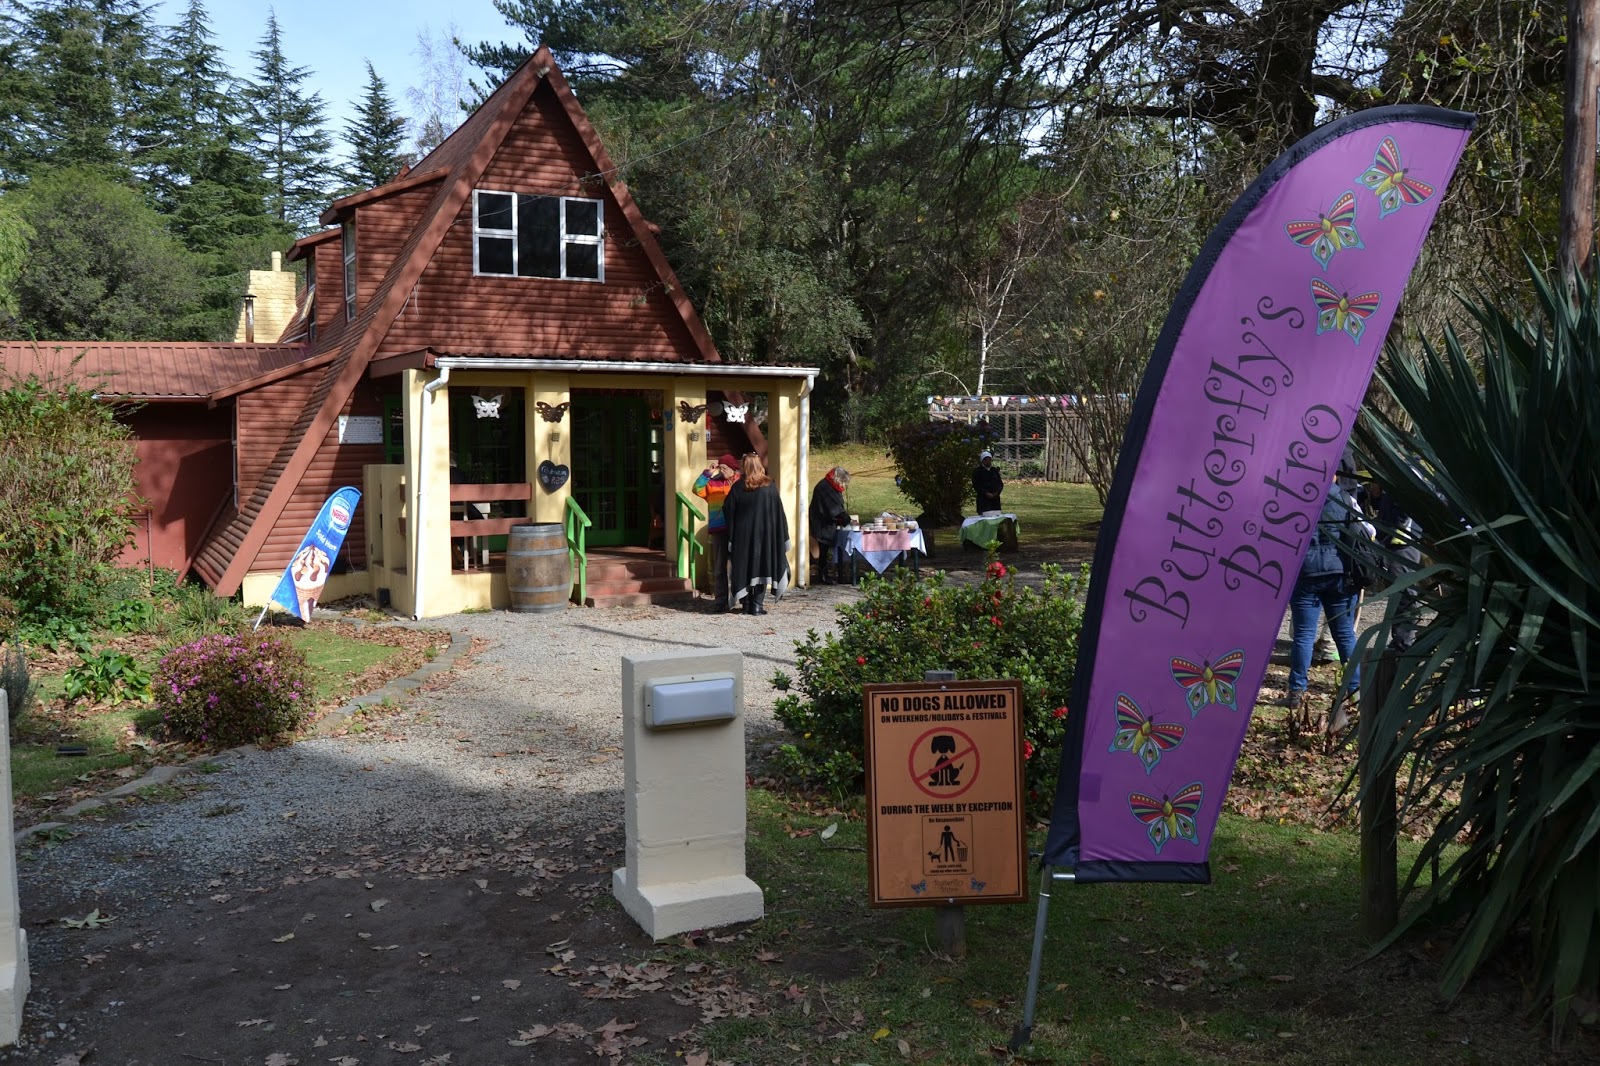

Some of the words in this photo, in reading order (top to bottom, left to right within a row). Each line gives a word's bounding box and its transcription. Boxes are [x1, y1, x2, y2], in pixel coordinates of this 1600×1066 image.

[1123, 296, 1304, 630] Butterfly's
[1218, 404, 1343, 600] Bistro
[315, 528, 327, 544] Sold
[324, 539, 338, 552] Here
[881, 697, 899, 712] NO
[903, 695, 940, 712] DOGS
[943, 694, 1007, 711] ALLOWED
[881, 715, 891, 723] ON
[892, 713, 964, 723] WEEKENDS/HOLIDAYS
[965, 713, 971, 721] &
[972, 712, 1007, 721] FESTIVALS
[881, 805, 913, 815] DURING
[914, 804, 929, 814] THE
[931, 803, 954, 813] WEEK
[956, 803, 967, 813] BY
[969, 801, 1013, 812] EXCEPTION
